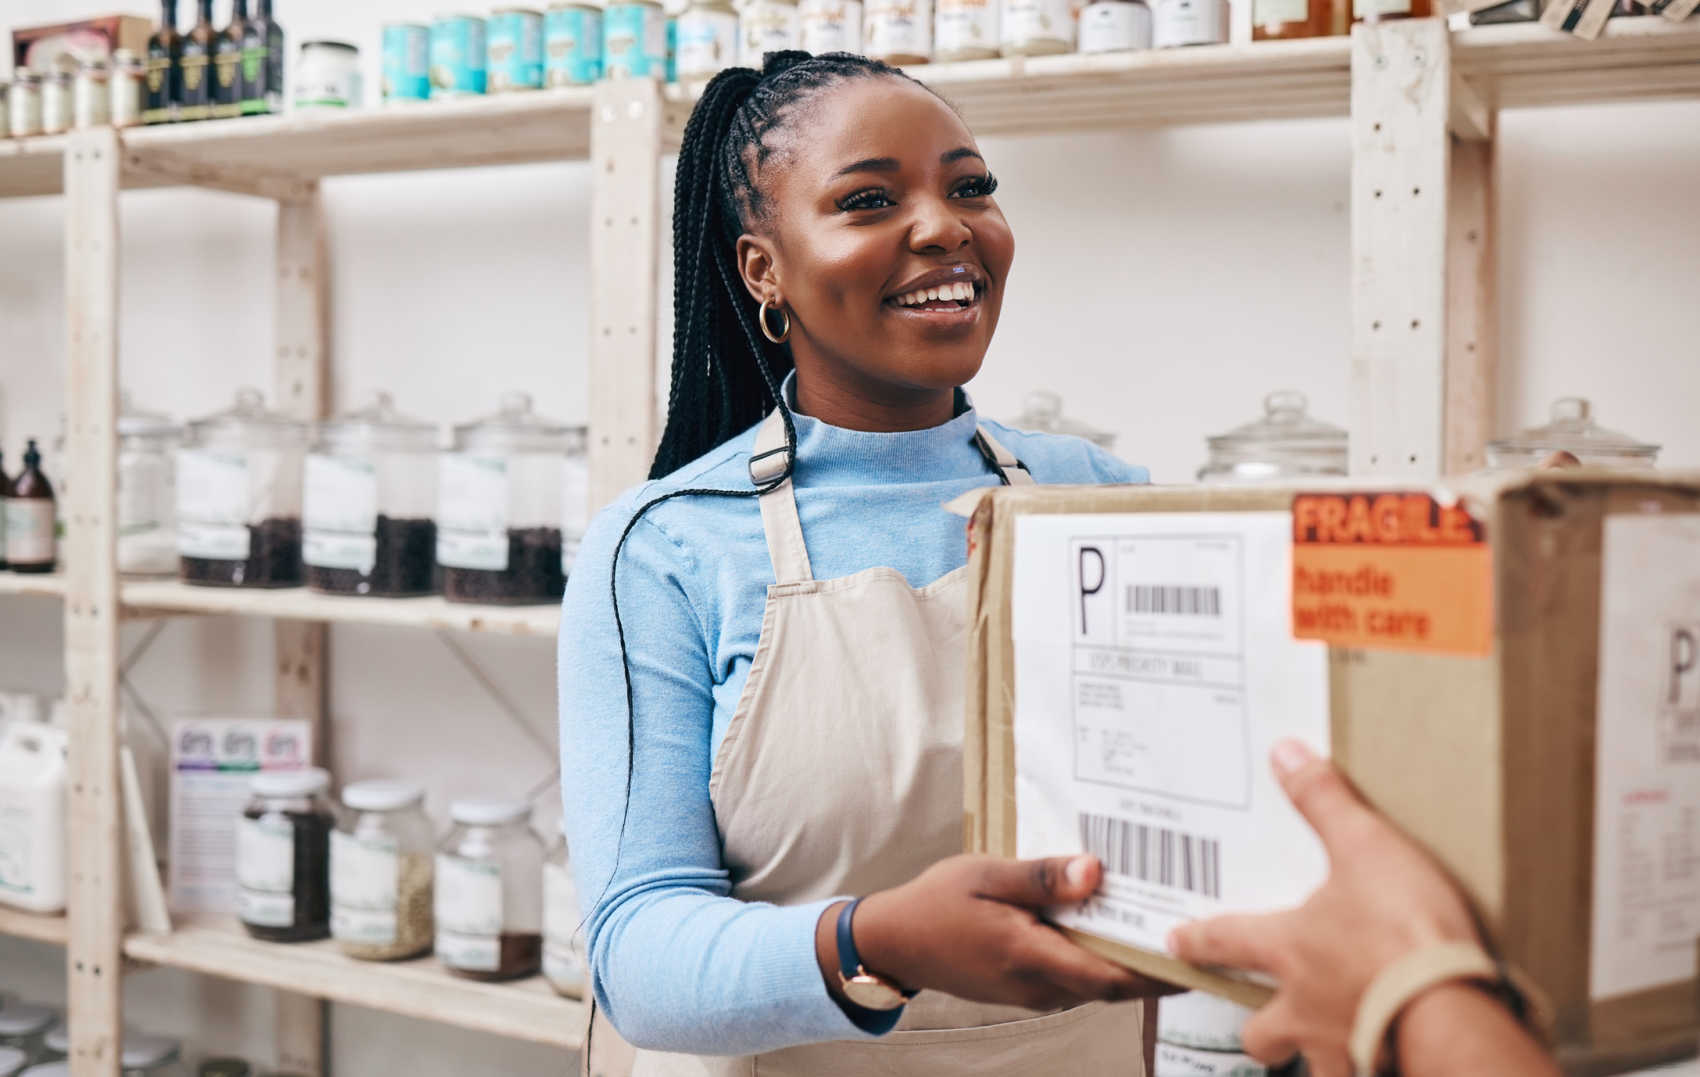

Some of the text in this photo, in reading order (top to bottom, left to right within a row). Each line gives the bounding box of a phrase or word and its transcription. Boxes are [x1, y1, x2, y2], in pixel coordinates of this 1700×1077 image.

[1294, 494, 1476, 544] FRAGILE
[1079, 547, 1105, 634] P
[1295, 566, 1391, 598] handle
[1295, 604, 1430, 640] with care
